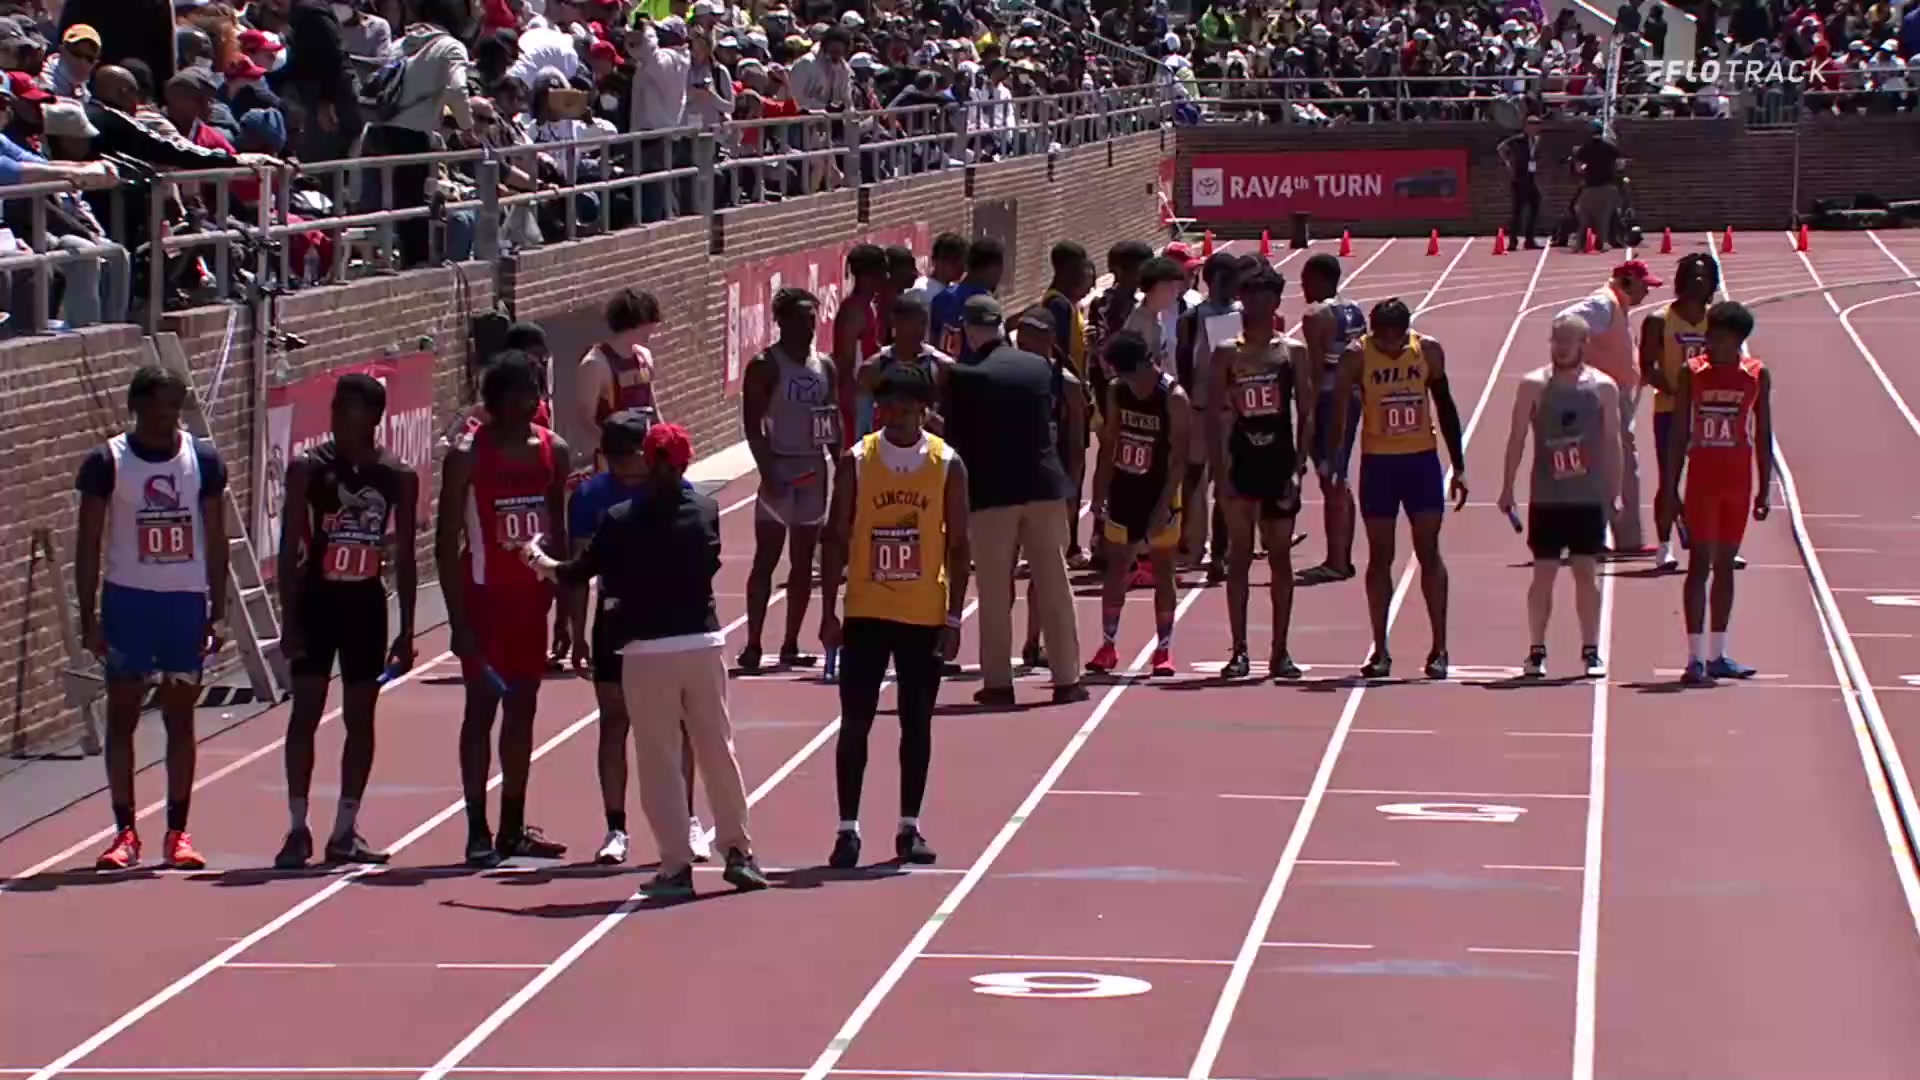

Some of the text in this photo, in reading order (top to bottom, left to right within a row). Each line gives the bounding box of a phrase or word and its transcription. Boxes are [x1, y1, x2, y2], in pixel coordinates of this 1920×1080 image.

[1315, 174, 1382, 198] TURN
[1371, 365, 1421, 385] MLK
[872, 490, 929, 510] LINCOLN
